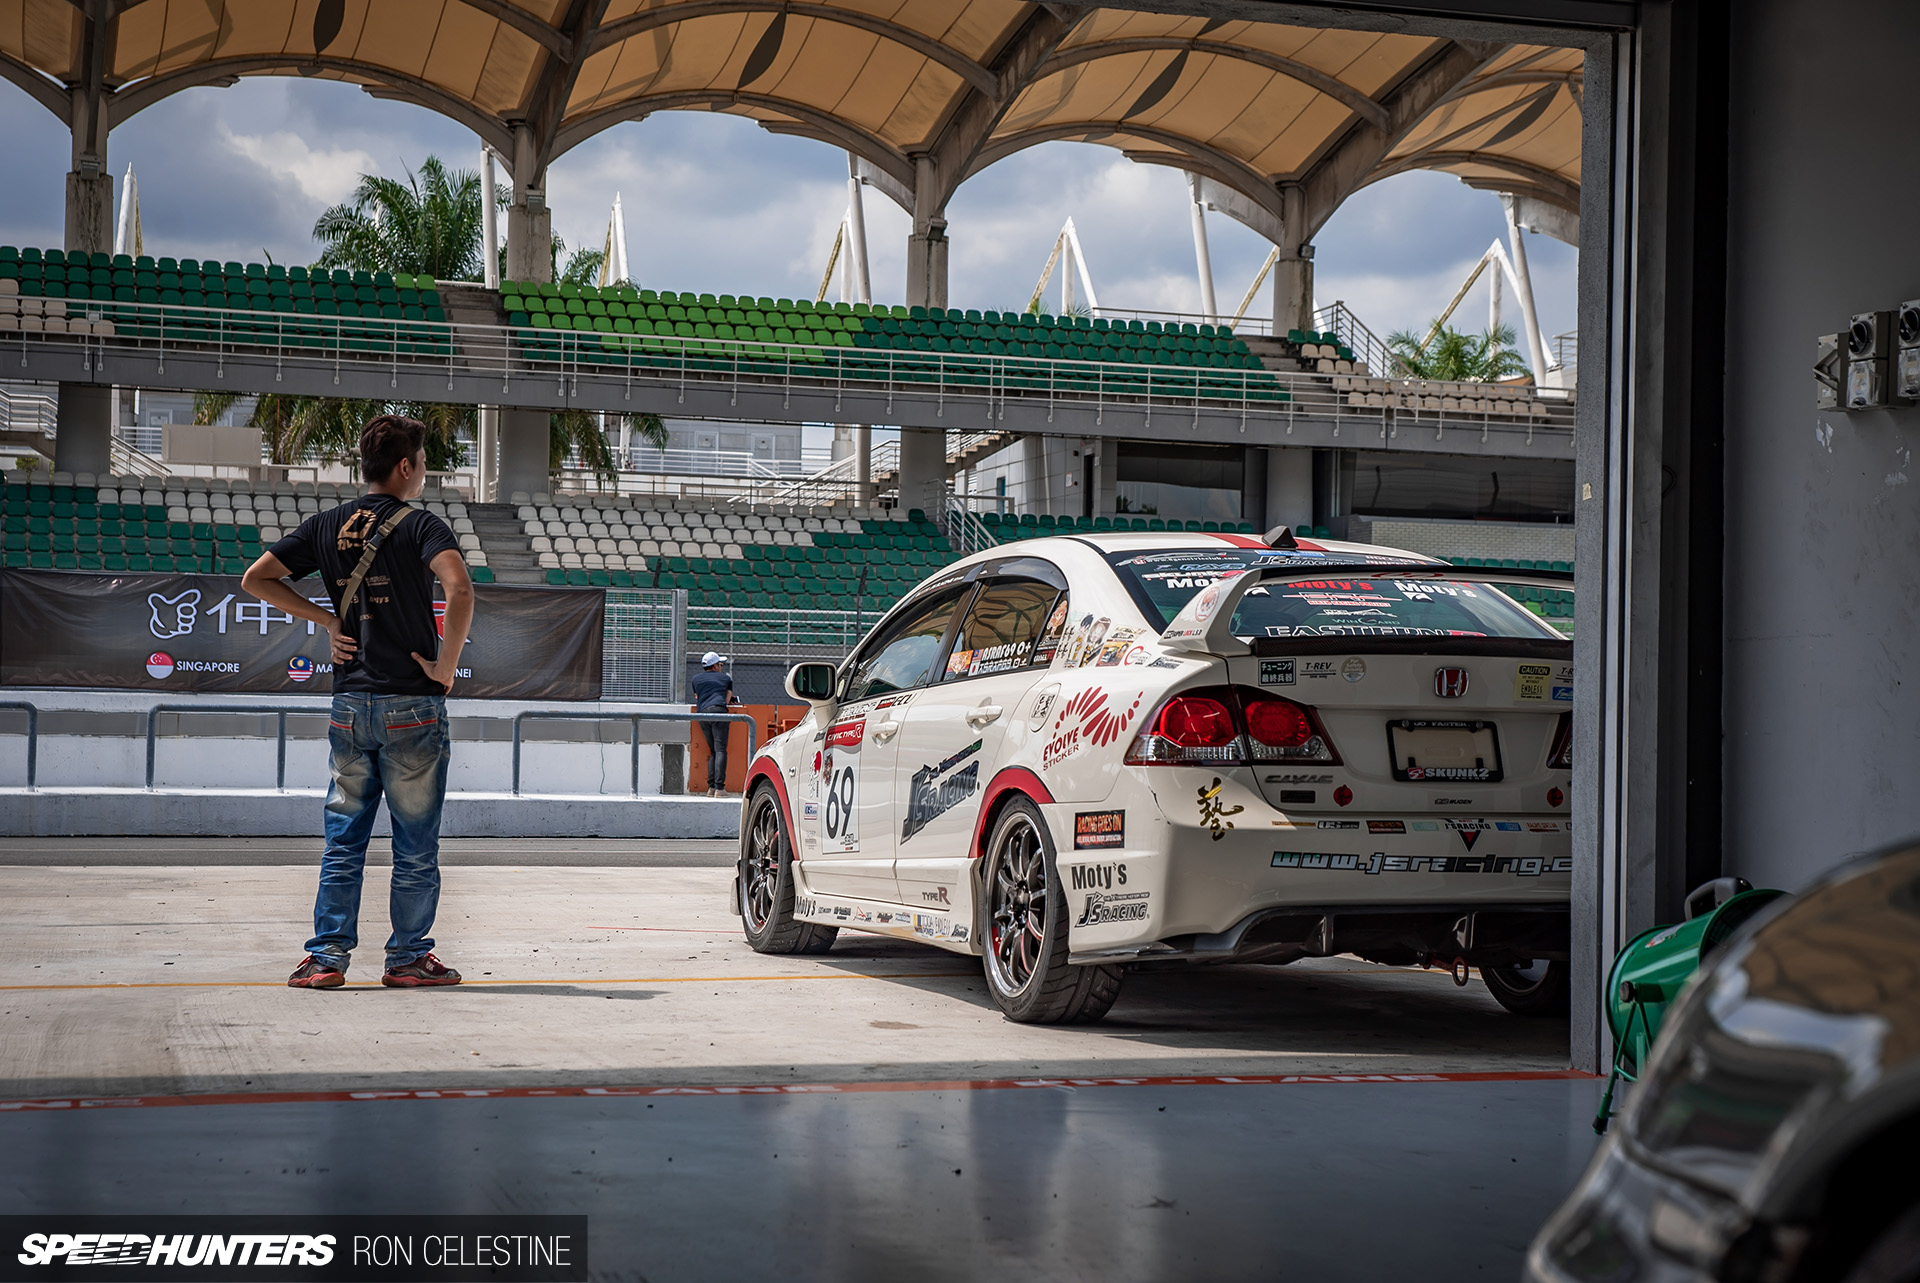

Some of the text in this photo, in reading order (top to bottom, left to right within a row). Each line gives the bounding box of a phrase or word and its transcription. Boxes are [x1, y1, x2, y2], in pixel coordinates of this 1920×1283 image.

[1394, 582, 1478, 599] Moty's
[176, 660, 240, 673] SINGAPORE
[315, 663, 333, 674] MA
[1306, 662, 1332, 670] T-REV
[1521, 666, 1549, 675] CAUTION
[1561, 667, 1574, 675] T-R
[455, 668, 472, 679] NEI
[1521, 684, 1543, 694] ENDLESS
[1043, 726, 1080, 762] EVOLVE
[1043, 743, 1080, 771] STICKER
[1424, 768, 1490, 778] SKUNK2
[1265, 775, 1335, 786] CIVIC
[826, 765, 855, 840] 69
[1077, 815, 1098, 833] RACING
[1113, 814, 1123, 831] ON
[1270, 851, 1573, 877] www.jsracing.c
[1071, 862, 1127, 890] Moty's
[922, 886, 951, 906] TYPE R
[0, 1098, 143, 1110] NE
